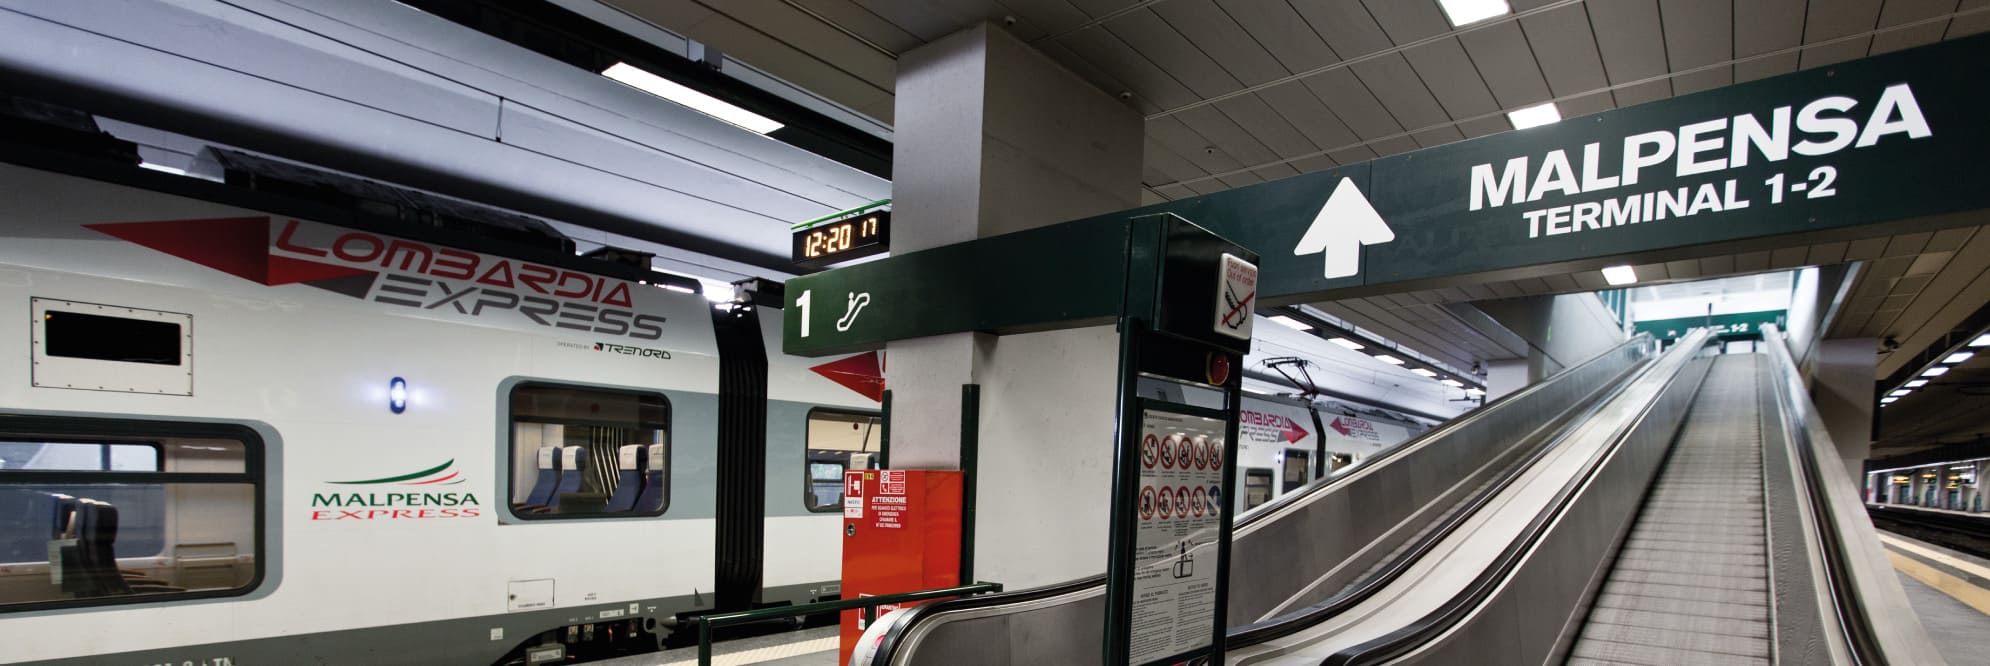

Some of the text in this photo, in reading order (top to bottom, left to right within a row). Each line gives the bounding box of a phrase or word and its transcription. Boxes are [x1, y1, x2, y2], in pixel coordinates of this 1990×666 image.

[1468, 82, 1933, 212] MALPENSA
[1523, 166, 1838, 239] TERMINAL 1-2
[805, 217, 878, 257] 12:20 17
[275, 219, 633, 308] LOMBARDIA
[374, 273, 667, 341] EXPRESS
[795, 289, 811, 338] 1
[605, 343, 672, 360] TRENORD
[1239, 409, 1291, 429] OMBARDIA
[312, 493, 479, 507] MALPENSA
[312, 509, 480, 520] EXPRESS
